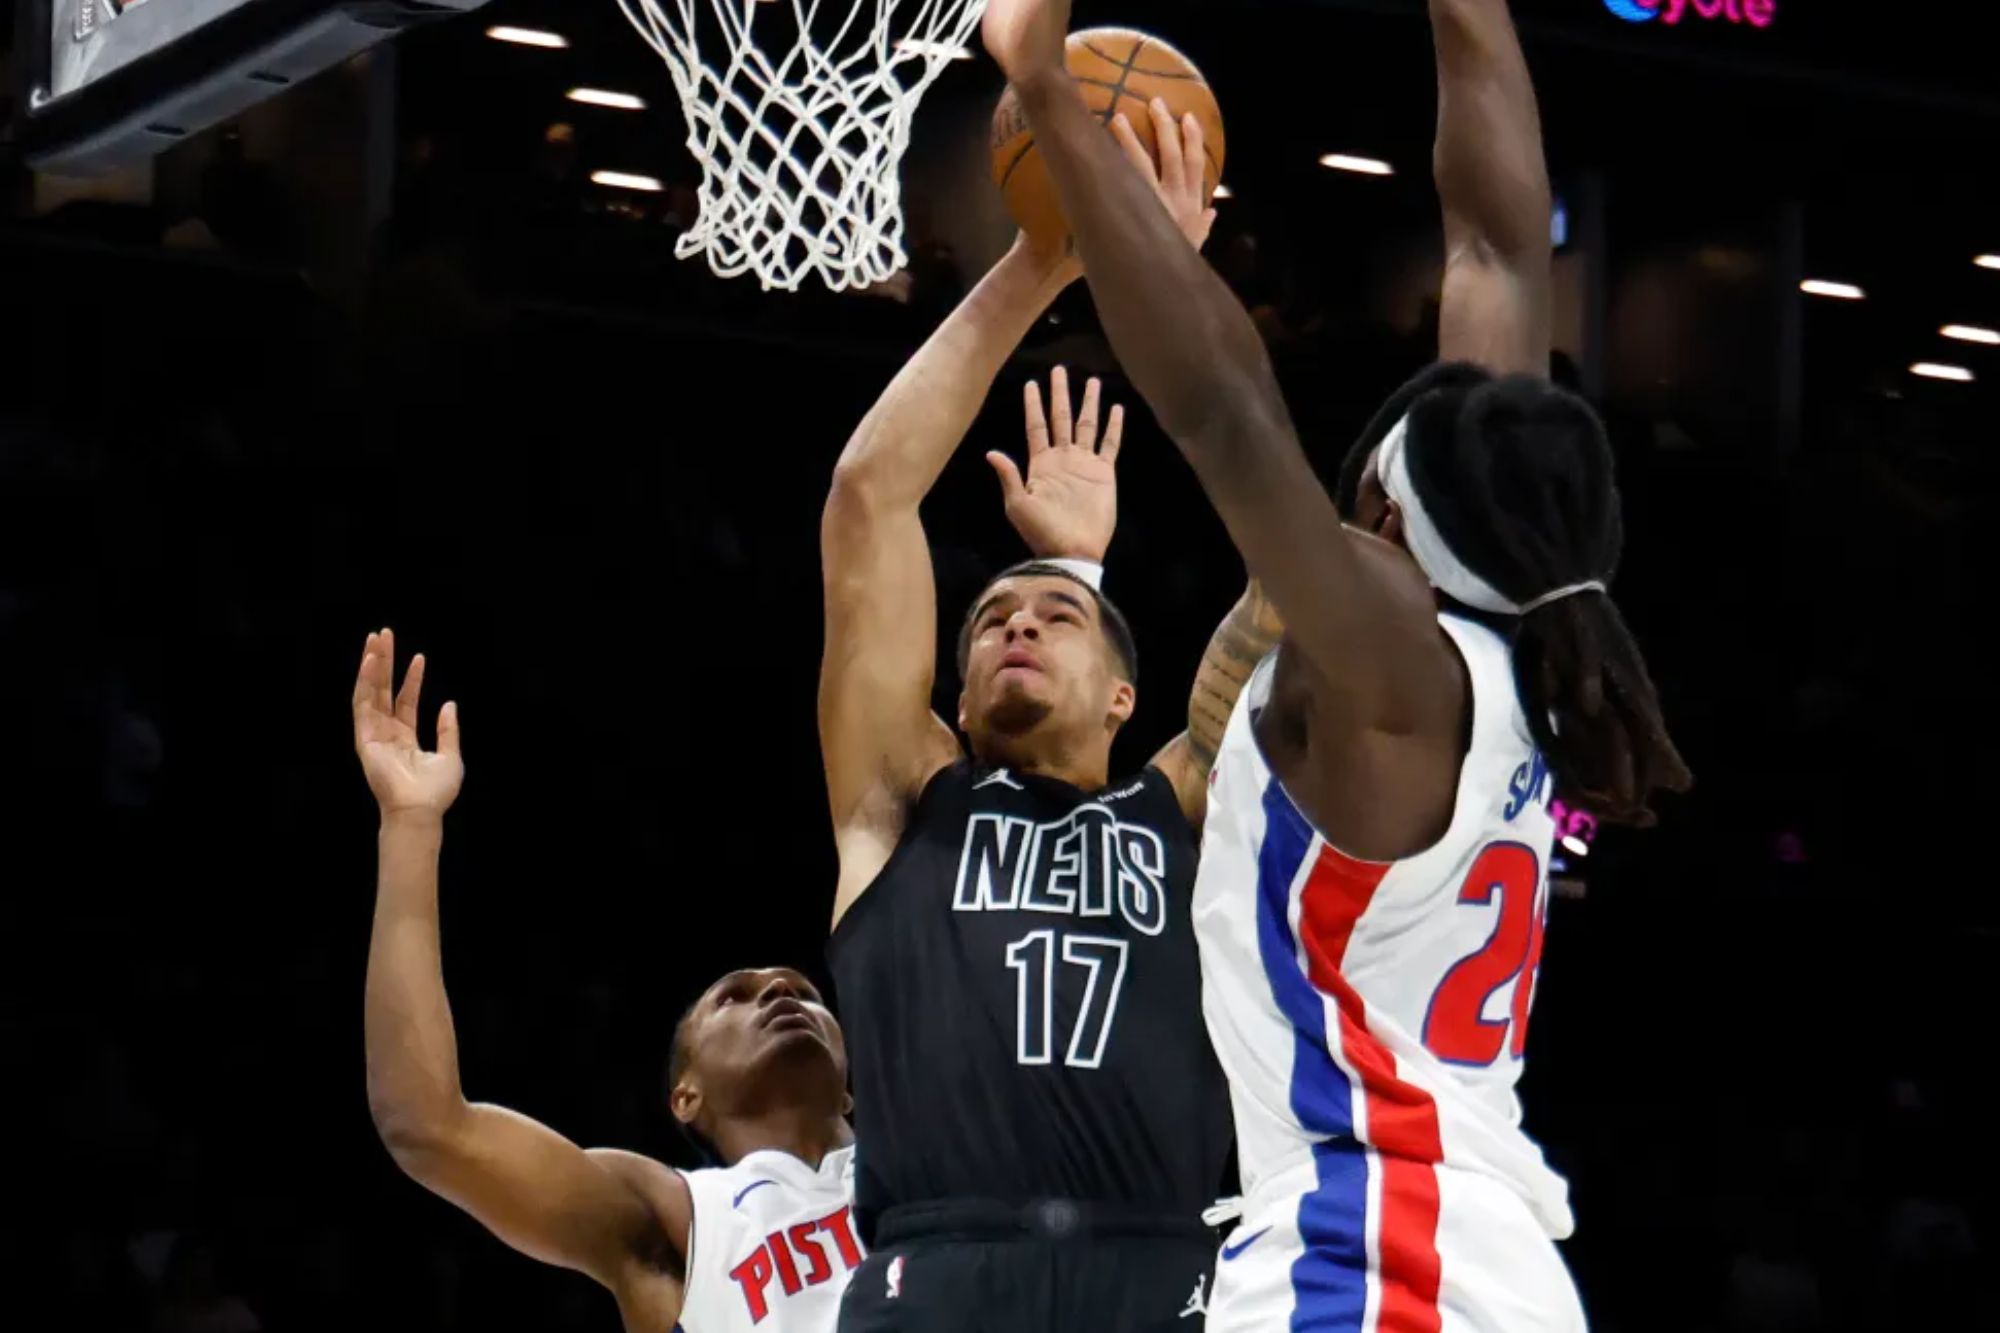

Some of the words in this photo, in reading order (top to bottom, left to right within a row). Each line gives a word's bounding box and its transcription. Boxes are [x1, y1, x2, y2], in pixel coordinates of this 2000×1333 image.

[952, 803, 1166, 936] NETS
[1005, 929, 1129, 1069] 17
[729, 1204, 862, 1325] PIST
